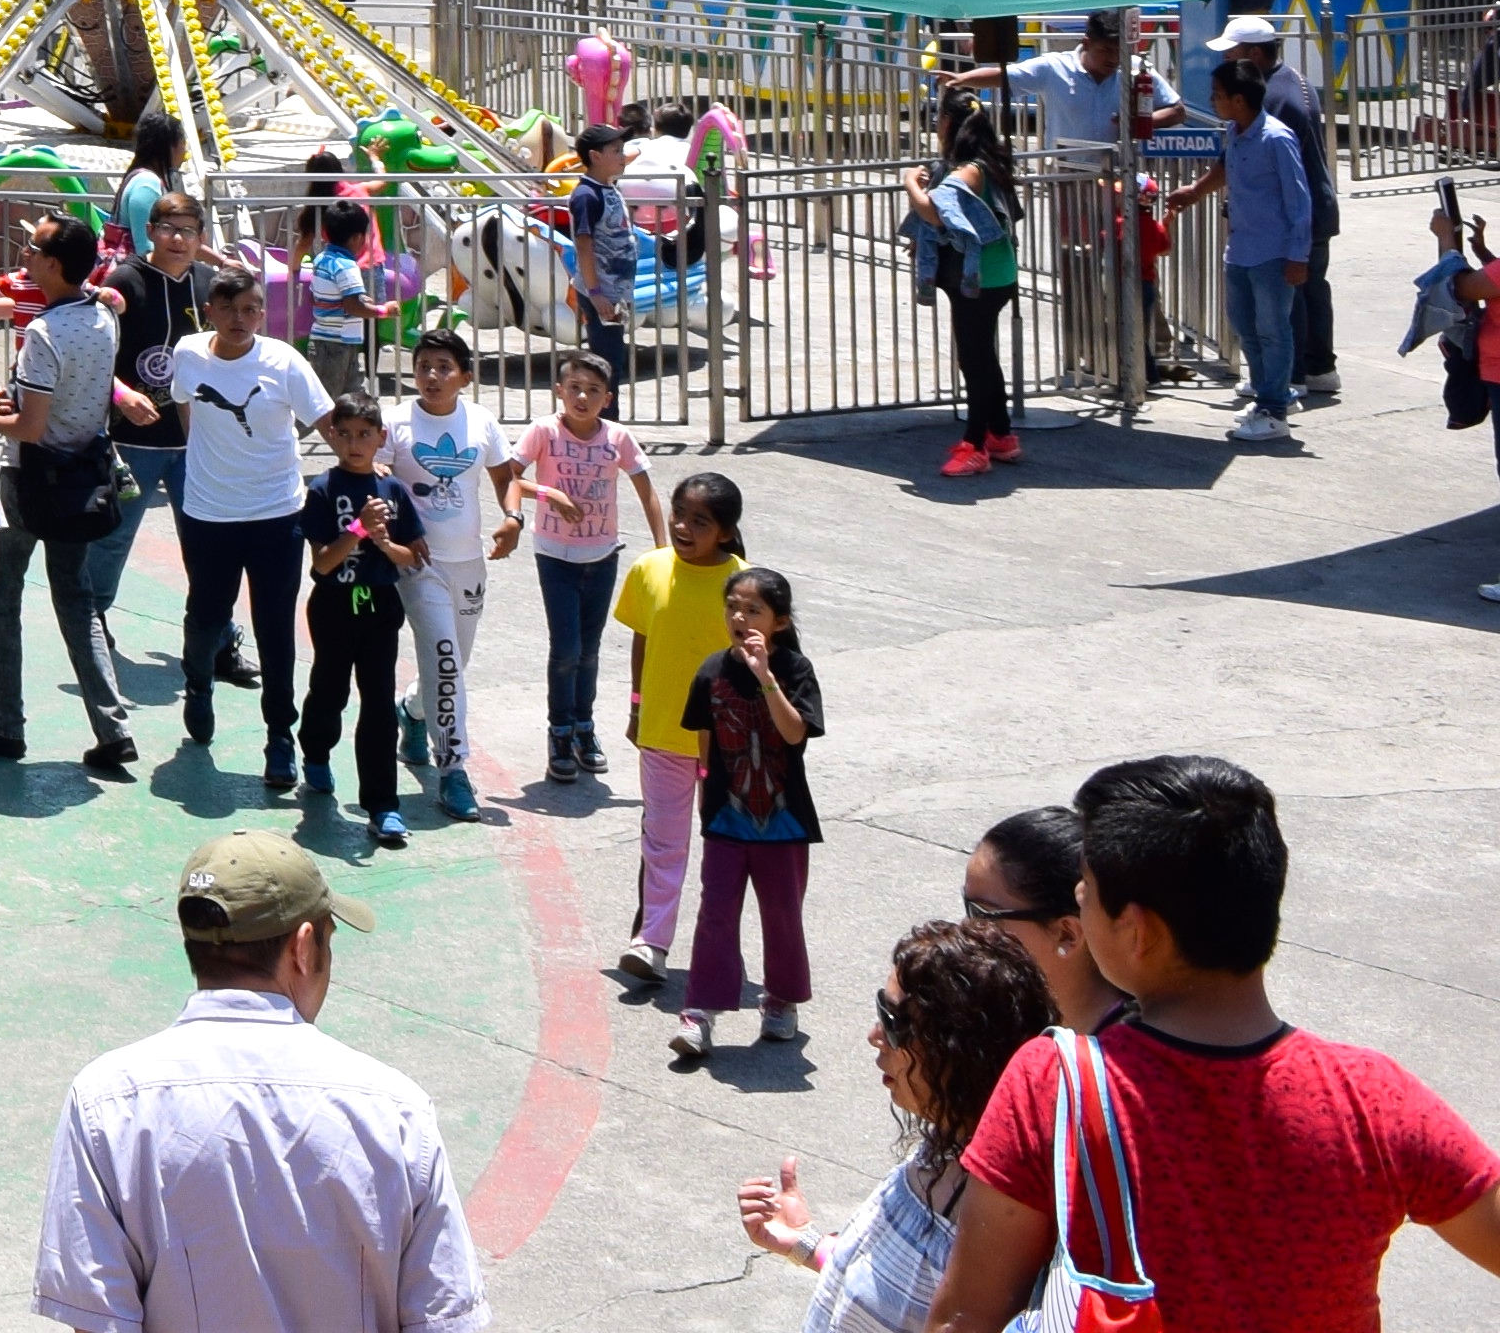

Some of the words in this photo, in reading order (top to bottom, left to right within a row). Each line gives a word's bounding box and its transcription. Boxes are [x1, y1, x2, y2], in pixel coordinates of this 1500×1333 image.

[1146, 136, 1216, 151] ENTRADA
[557, 462, 606, 478] GET
[436, 638, 458, 728] adidas
